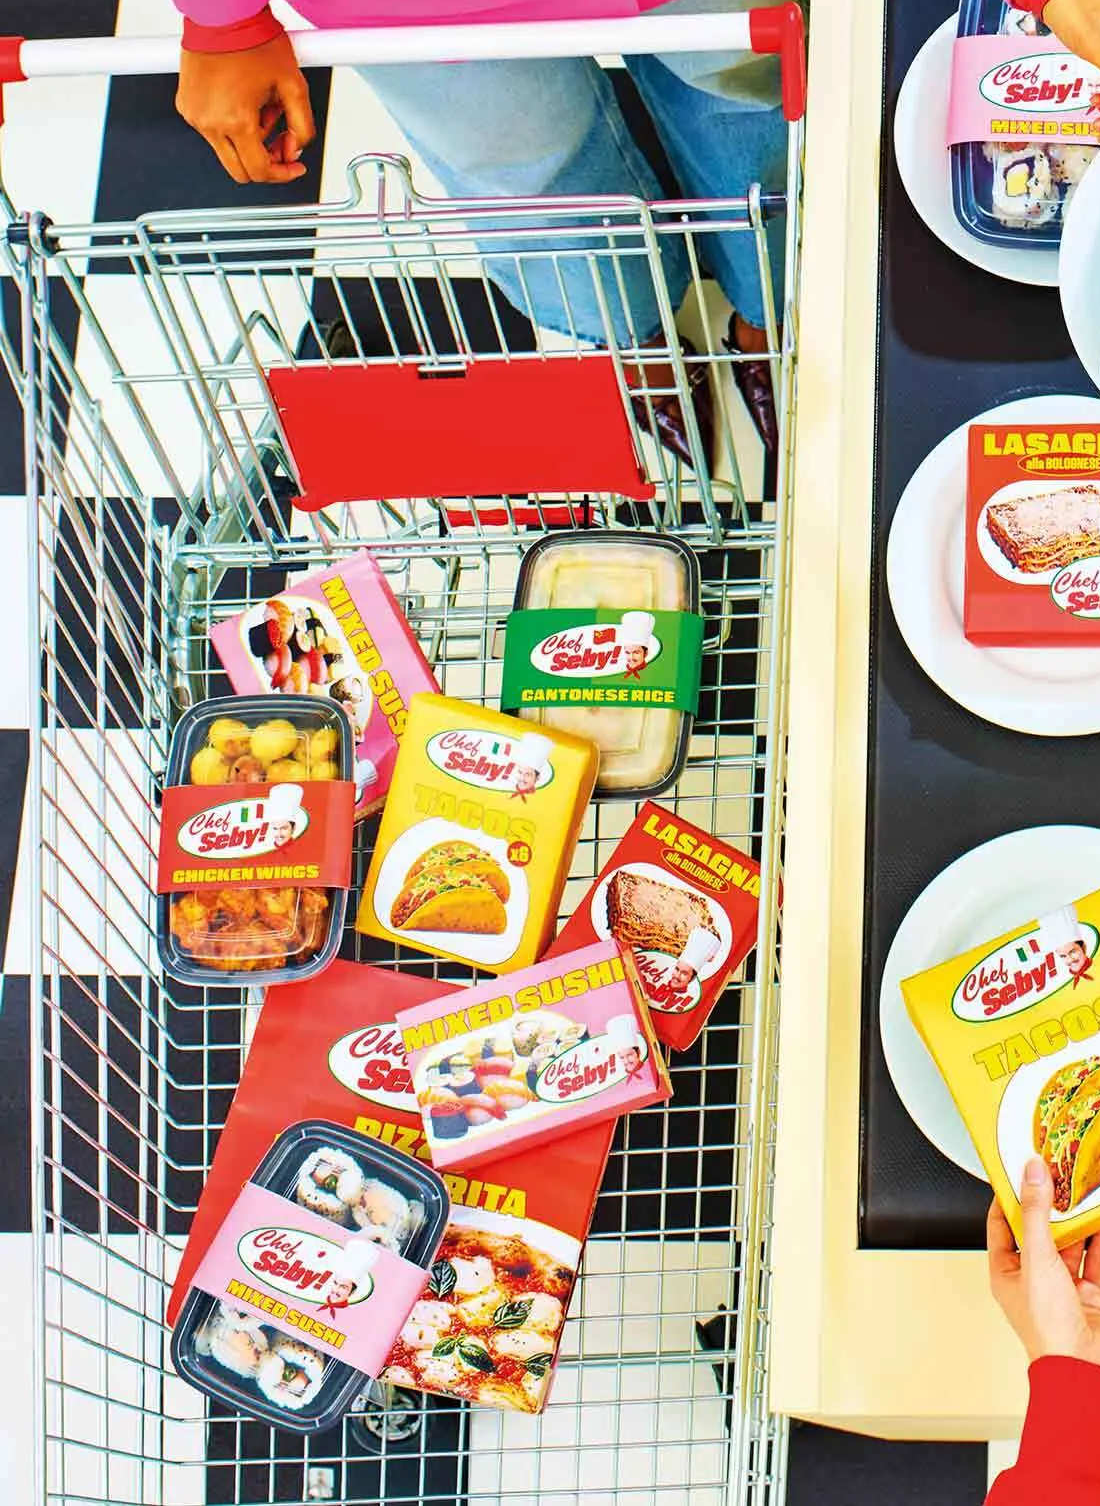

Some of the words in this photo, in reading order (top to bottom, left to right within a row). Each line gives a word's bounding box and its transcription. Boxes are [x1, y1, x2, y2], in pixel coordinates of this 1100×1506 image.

[993, 64, 1041, 86] Chef
[1004, 78, 1084, 105] Seby!
[991, 119, 1059, 135] MIXED
[1053, 570, 1100, 594] Chef
[320, 574, 383, 674] MIXED
[368, 669, 408, 737] SUS
[541, 634, 584, 655] Chef
[551, 646, 622, 672] Seby!
[521, 688, 629, 702] CANTONESE
[631, 689, 676, 703] RICE
[438, 731, 482, 757] Chef
[444, 751, 515, 782] Seby!
[189, 810, 232, 835] Chef
[413, 783, 537, 845] TACOS
[198, 822, 269, 853] Seby!
[642, 813, 760, 899] LASAGNA
[665, 851, 681, 867] alla
[681, 859, 724, 891] BOLOGNESE
[172, 867, 255, 885] CHICKEN
[256, 864, 320, 880] WINGS
[642, 975, 694, 1012] eby!
[962, 958, 1008, 1002] Chef
[981, 951, 1058, 1016] Seby!
[403, 995, 515, 1052] MIXED
[515, 957, 625, 1013] SUSHI
[350, 1028, 408, 1067] Che
[543, 1057, 580, 1086] Chef
[557, 1056, 616, 1099] Seby!
[253, 1229, 302, 1259] Chef
[254, 1250, 334, 1291] Seby!
[225, 1278, 288, 1319] MIXED
[286, 1308, 347, 1350] SUSHI
